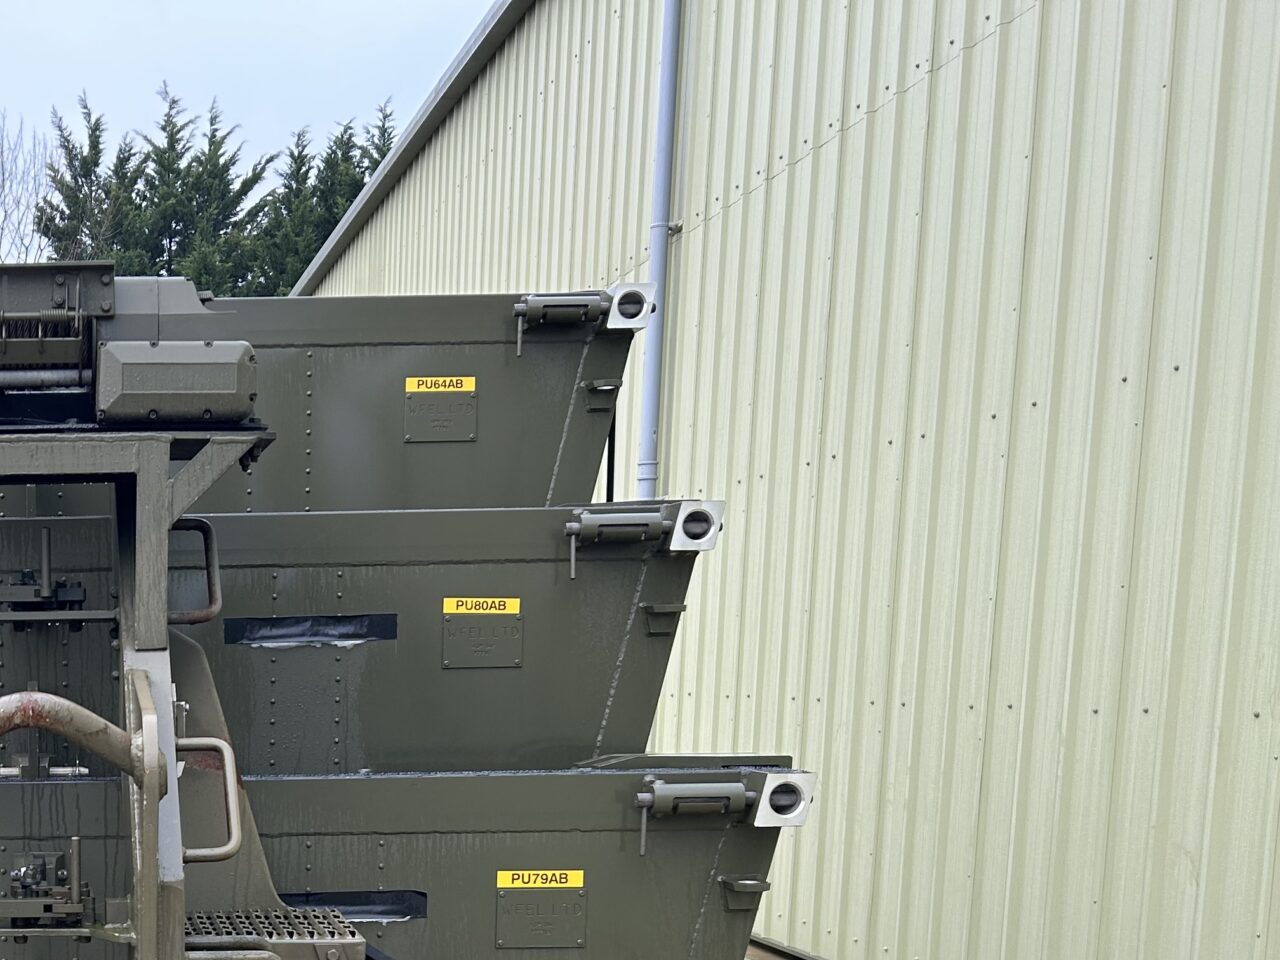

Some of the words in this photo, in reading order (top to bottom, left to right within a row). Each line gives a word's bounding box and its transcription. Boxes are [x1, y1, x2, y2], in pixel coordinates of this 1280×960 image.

[417, 379, 464, 389] PU64AB
[456, 600, 507, 611] PU80AB
[511, 873, 569, 885] PU79AB
